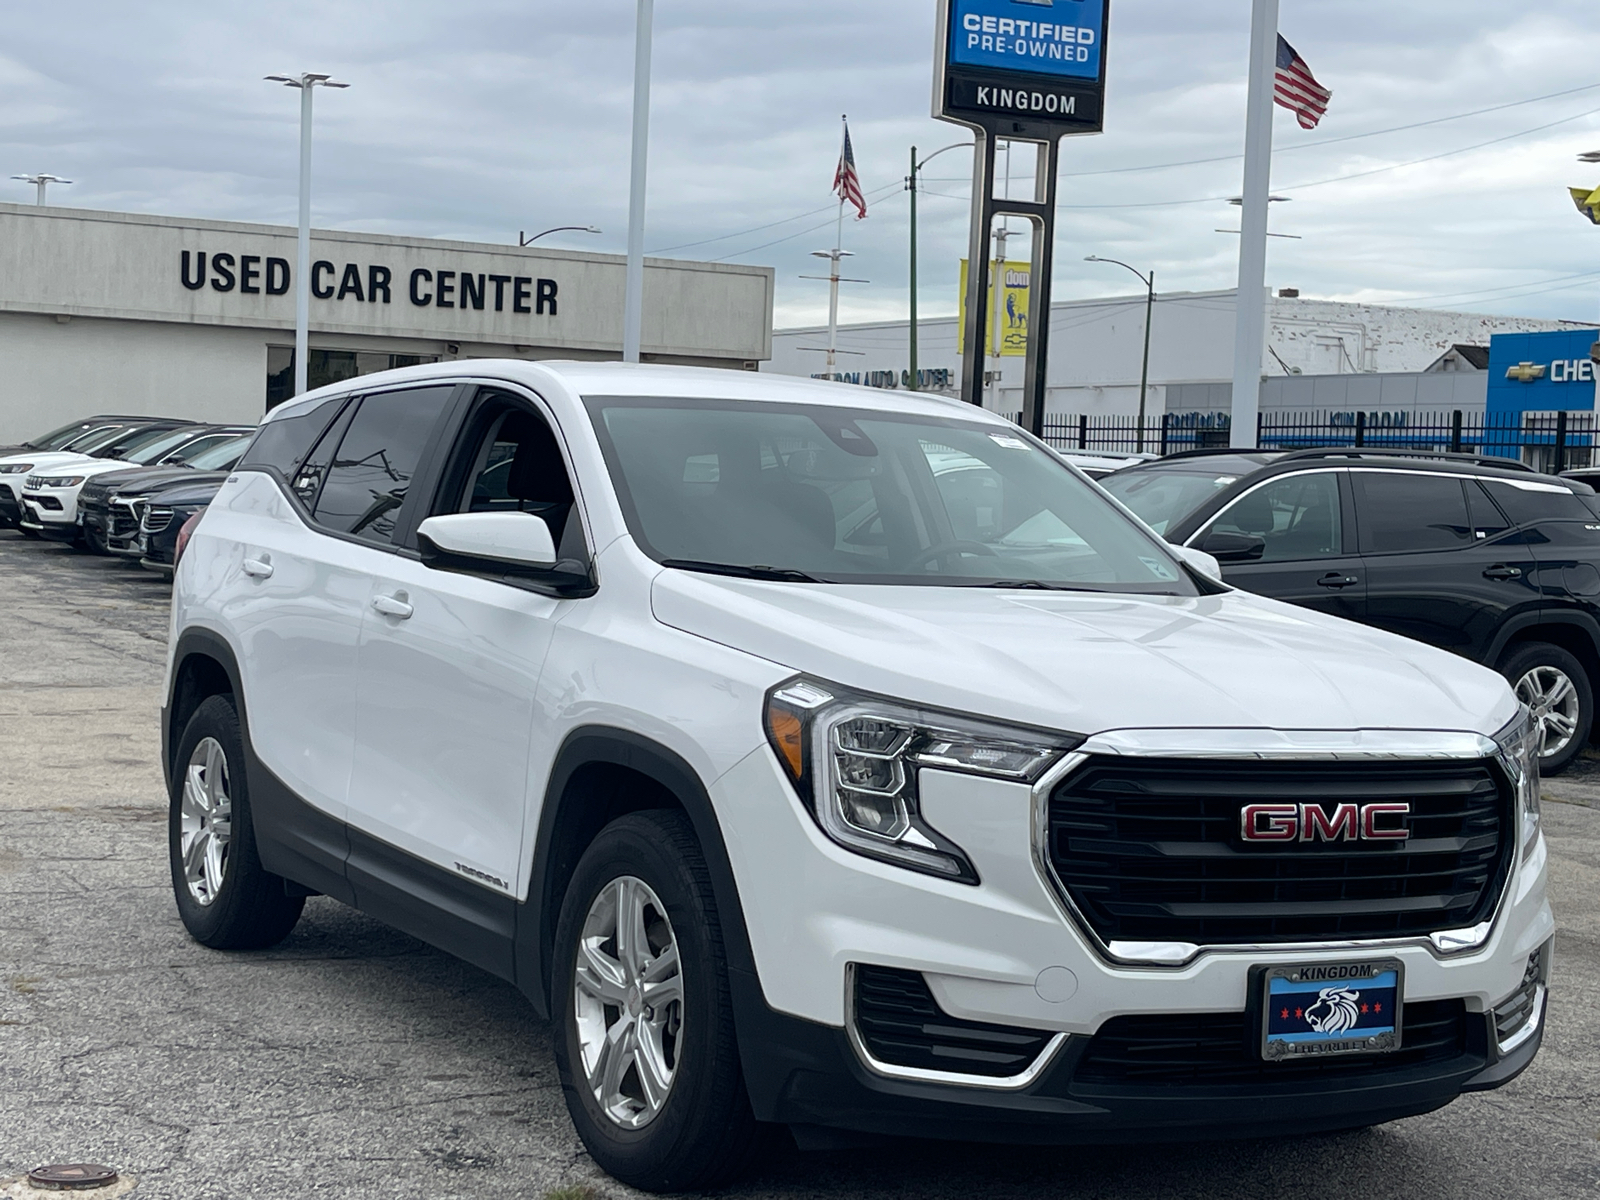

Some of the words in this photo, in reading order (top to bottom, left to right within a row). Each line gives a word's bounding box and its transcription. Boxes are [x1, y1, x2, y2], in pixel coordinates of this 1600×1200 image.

[963, 13, 1095, 45] CERTIFIED
[967, 33, 1089, 63] PRE-OWNED
[977, 86, 1076, 115] KINGDOM
[181, 250, 291, 295] USED
[311, 260, 392, 304] CAR
[409, 268, 559, 316] CENTER
[901, 368, 953, 387] CNTER
[1330, 411, 1406, 427] KINDOM
[1241, 803, 1410, 842] GMC
[1300, 964, 1372, 980] KINGDOM
[1294, 1040, 1367, 1054] CHEVROLET
